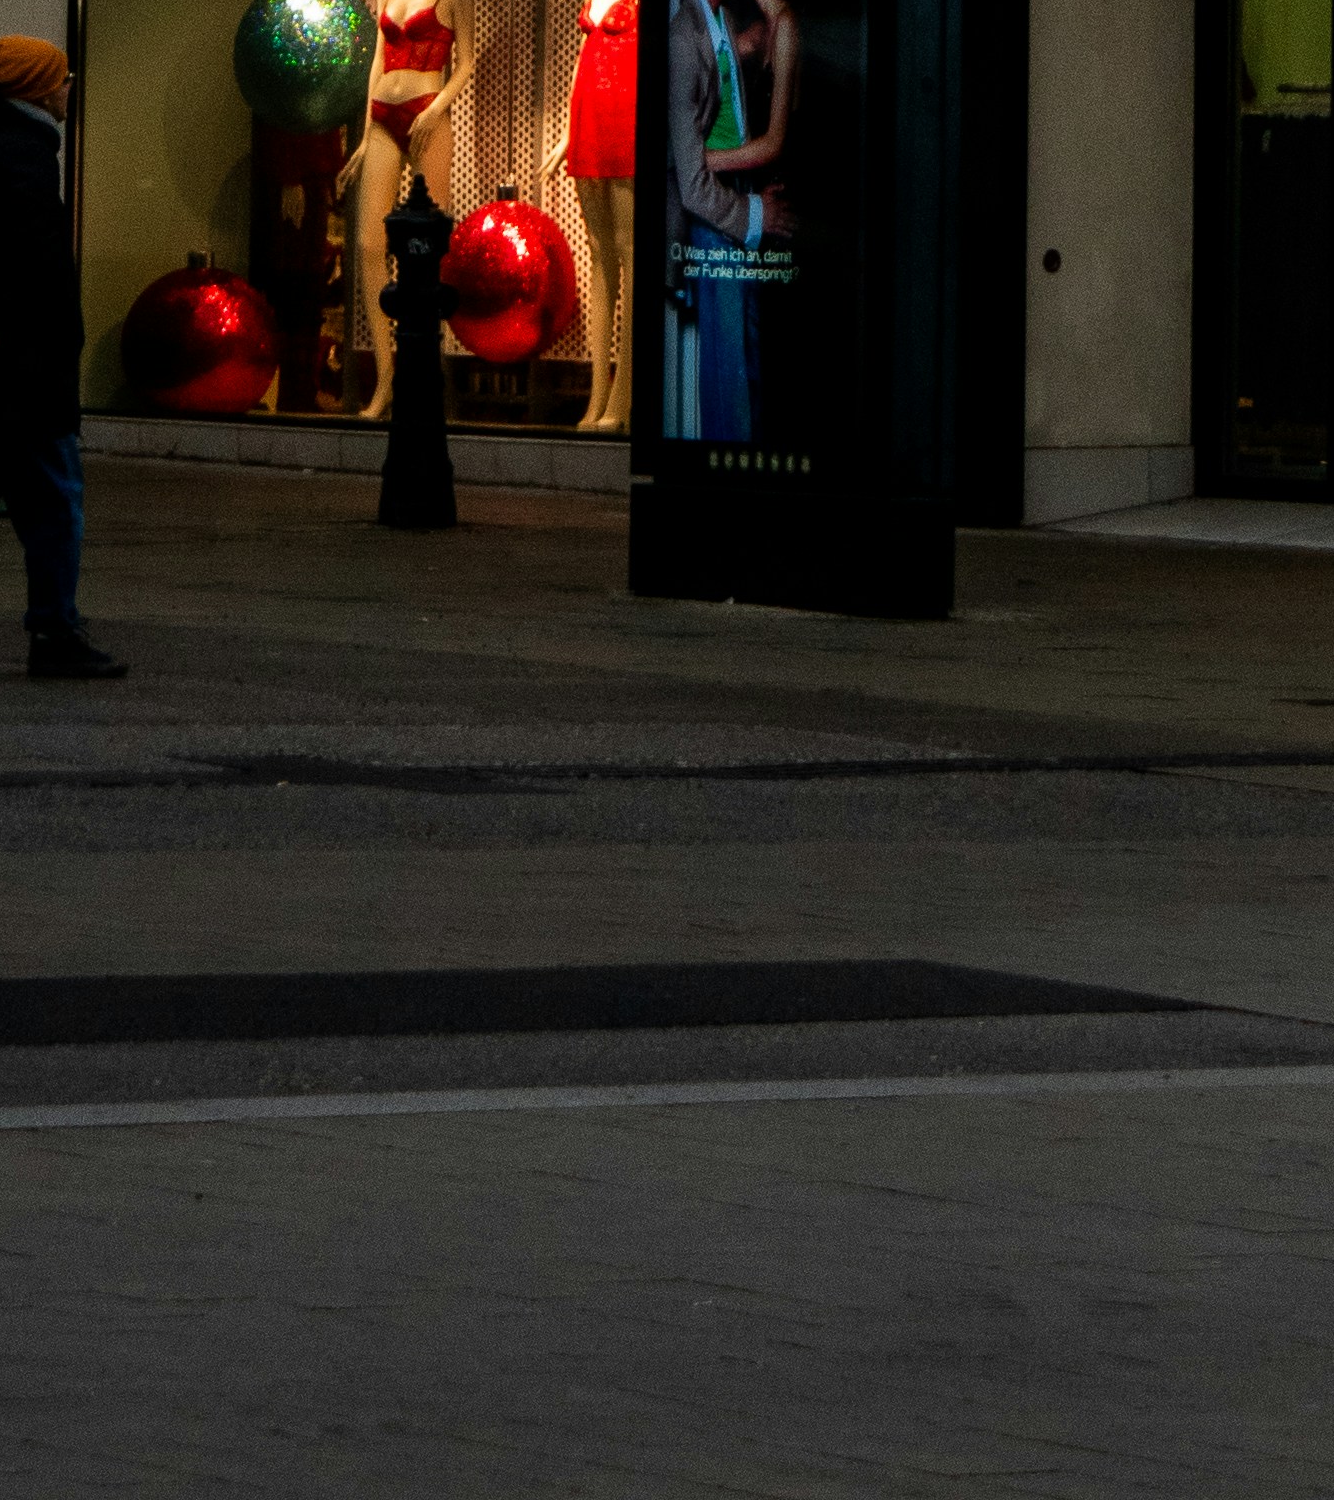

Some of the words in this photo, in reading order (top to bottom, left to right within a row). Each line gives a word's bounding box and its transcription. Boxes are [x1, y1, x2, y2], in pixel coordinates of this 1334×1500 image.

[684, 245, 706, 260] Was
[730, 248, 745, 261] ich
[683, 264, 700, 277] der
[702, 263, 733, 279] Funke
